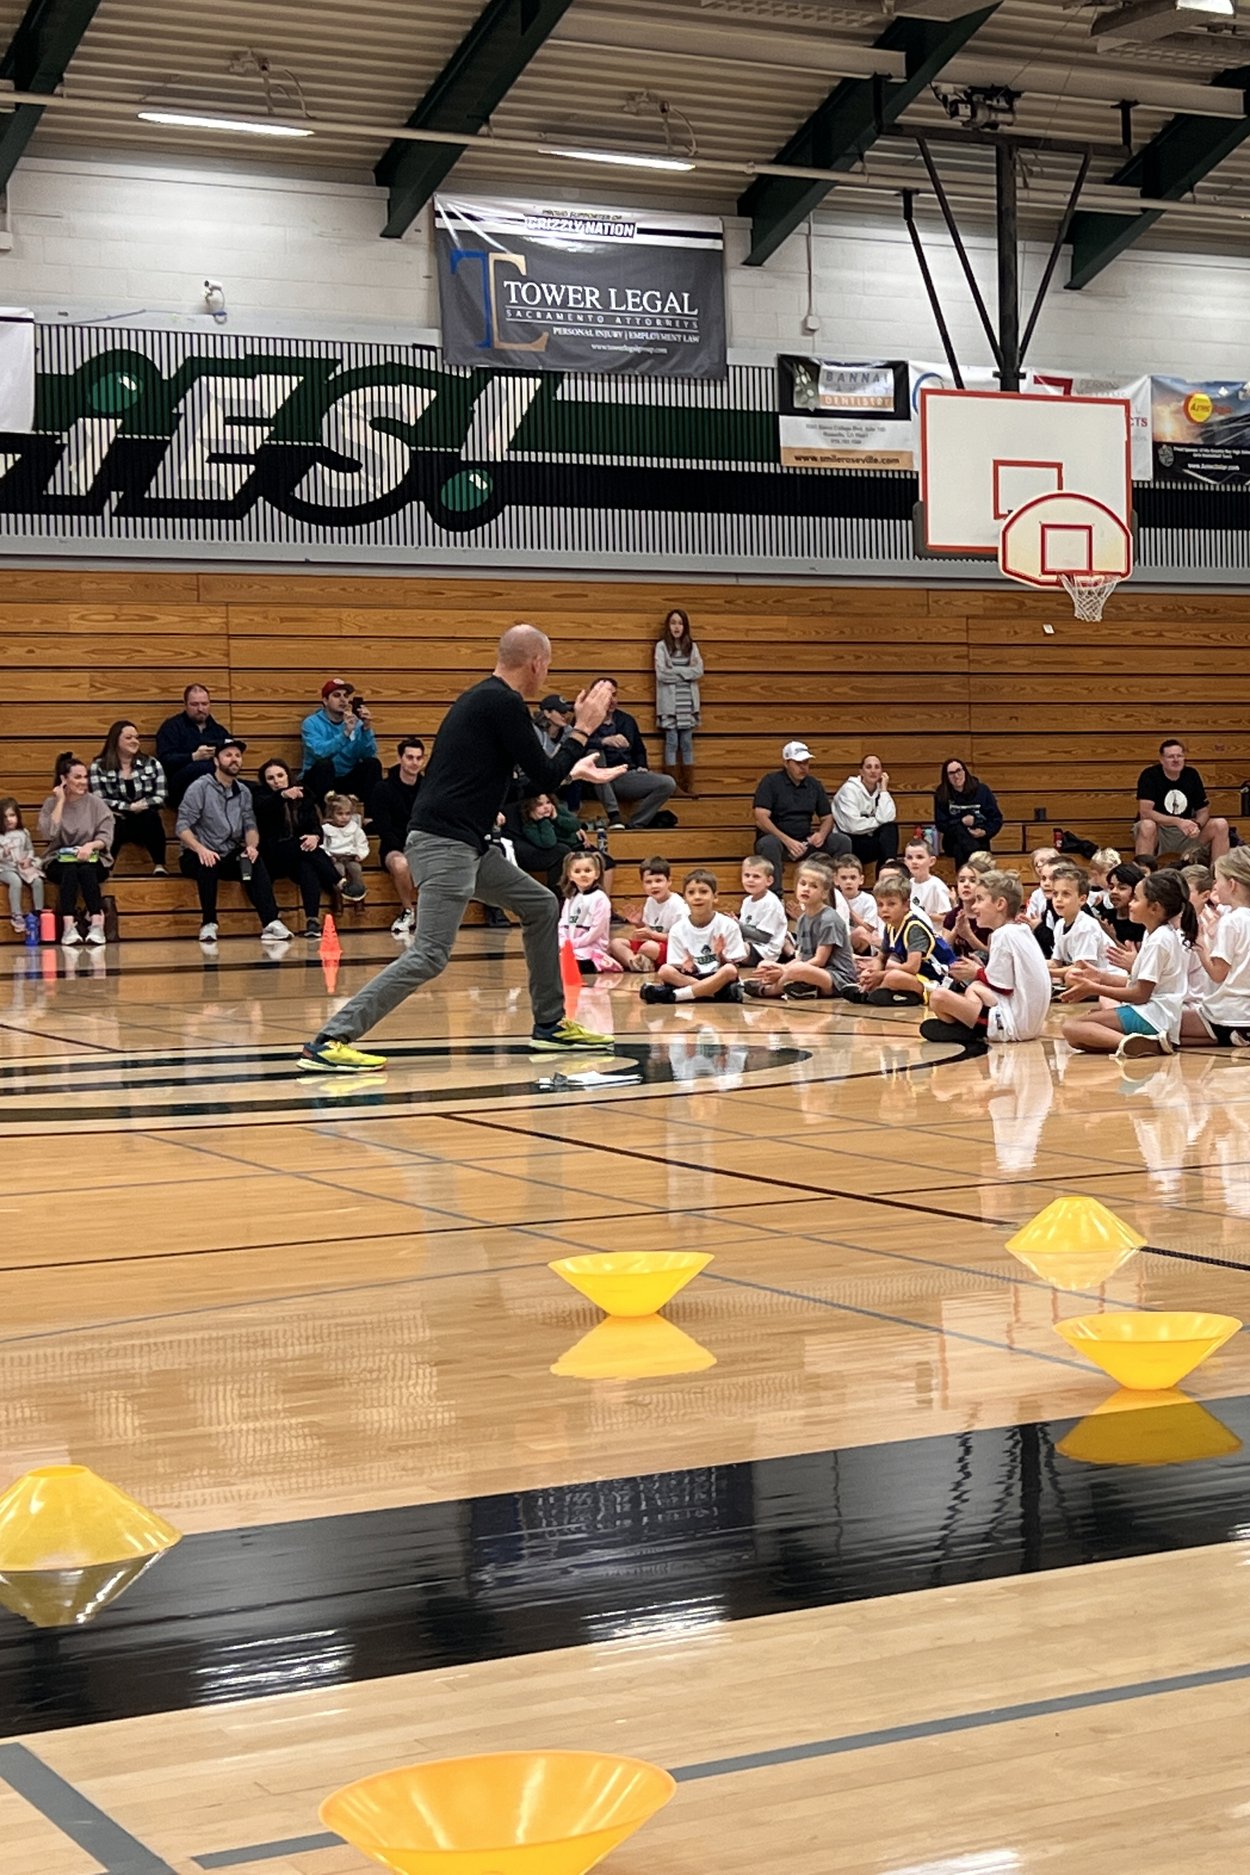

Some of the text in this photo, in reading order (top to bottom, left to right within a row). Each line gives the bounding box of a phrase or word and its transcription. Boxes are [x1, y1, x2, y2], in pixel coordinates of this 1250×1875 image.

[585, 222, 633, 237] NATION
[503, 281, 698, 315] TOWER LEGAL
[506, 309, 698, 330] SACRAMENTO ATTORNEYS
[553, 326, 594, 338] PERSONAL
[595, 329, 623, 340] INJURY
[629, 332, 682, 343] EMPLOYMENT
[683, 335, 699, 344] LAW
